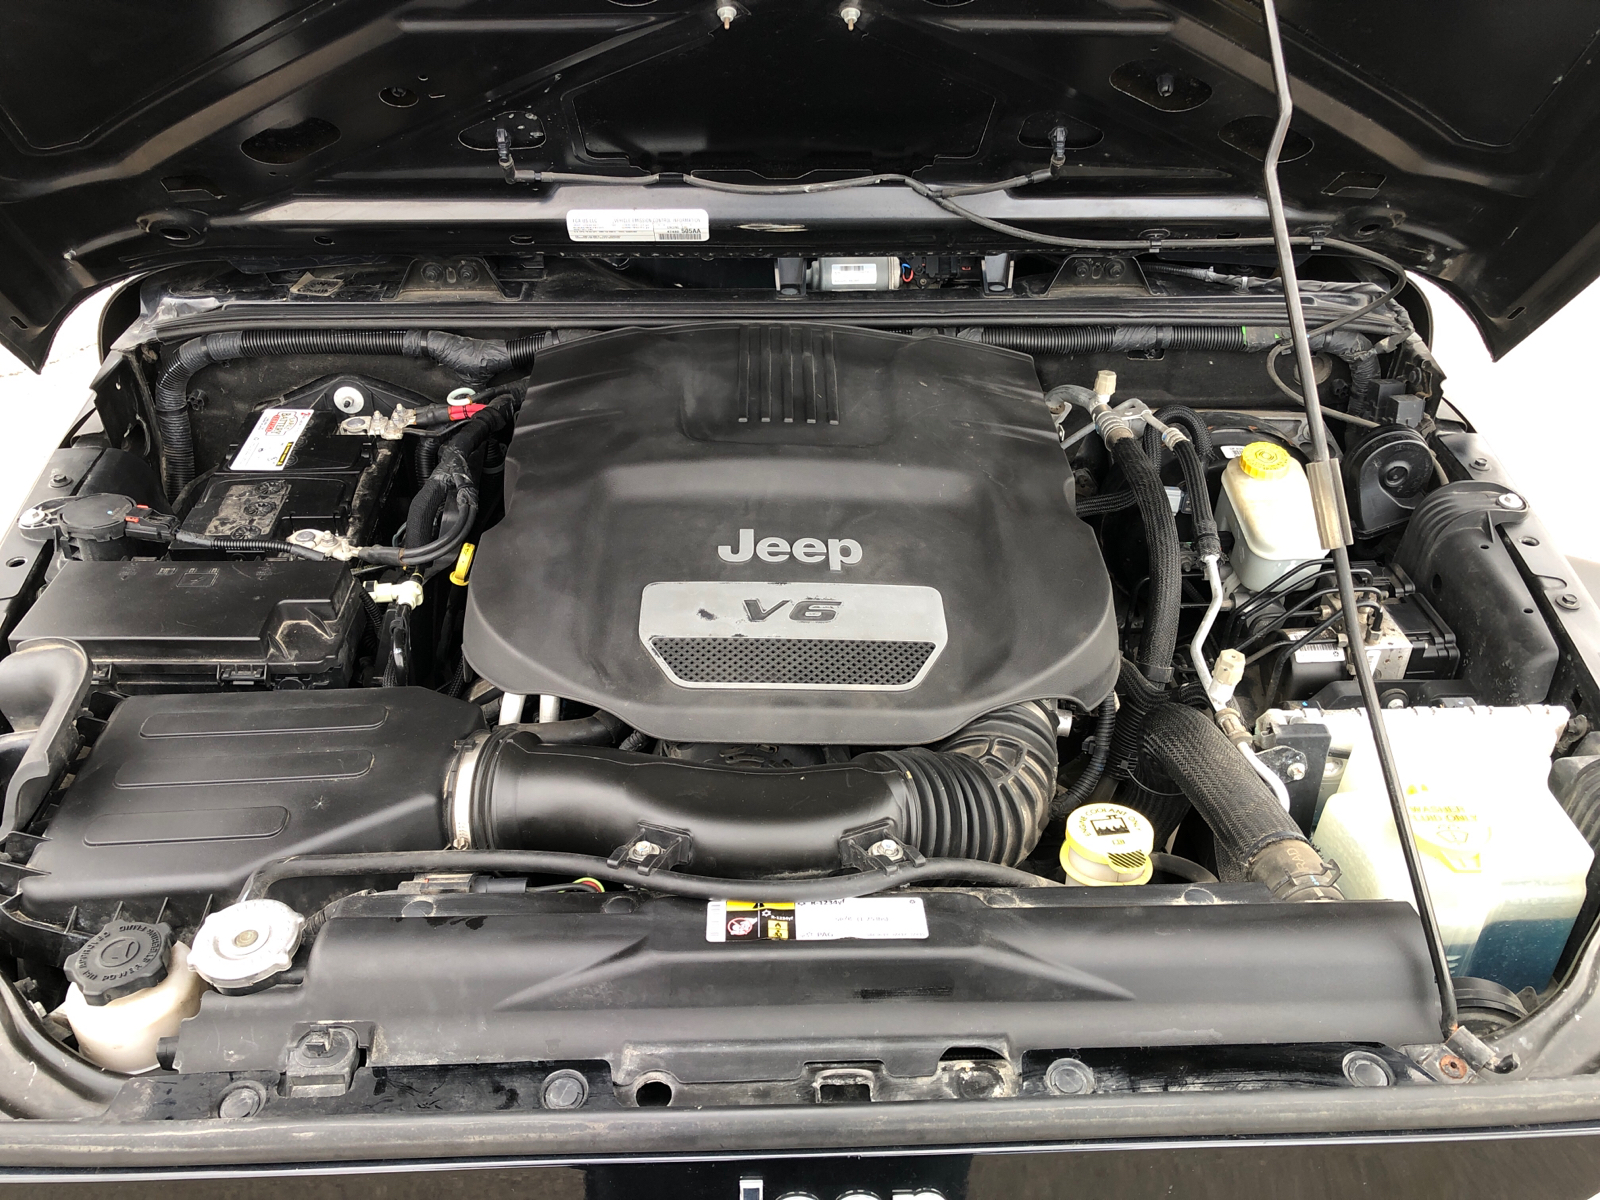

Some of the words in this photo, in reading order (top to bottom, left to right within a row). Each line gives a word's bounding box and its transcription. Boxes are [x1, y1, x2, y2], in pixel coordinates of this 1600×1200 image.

[717, 528, 863, 571] Jeep
[743, 599, 842, 622] V6
[1086, 808, 1127, 816] COOLANT
[119, 924, 146, 933] FLUID
[102, 964, 142, 981] POWER
